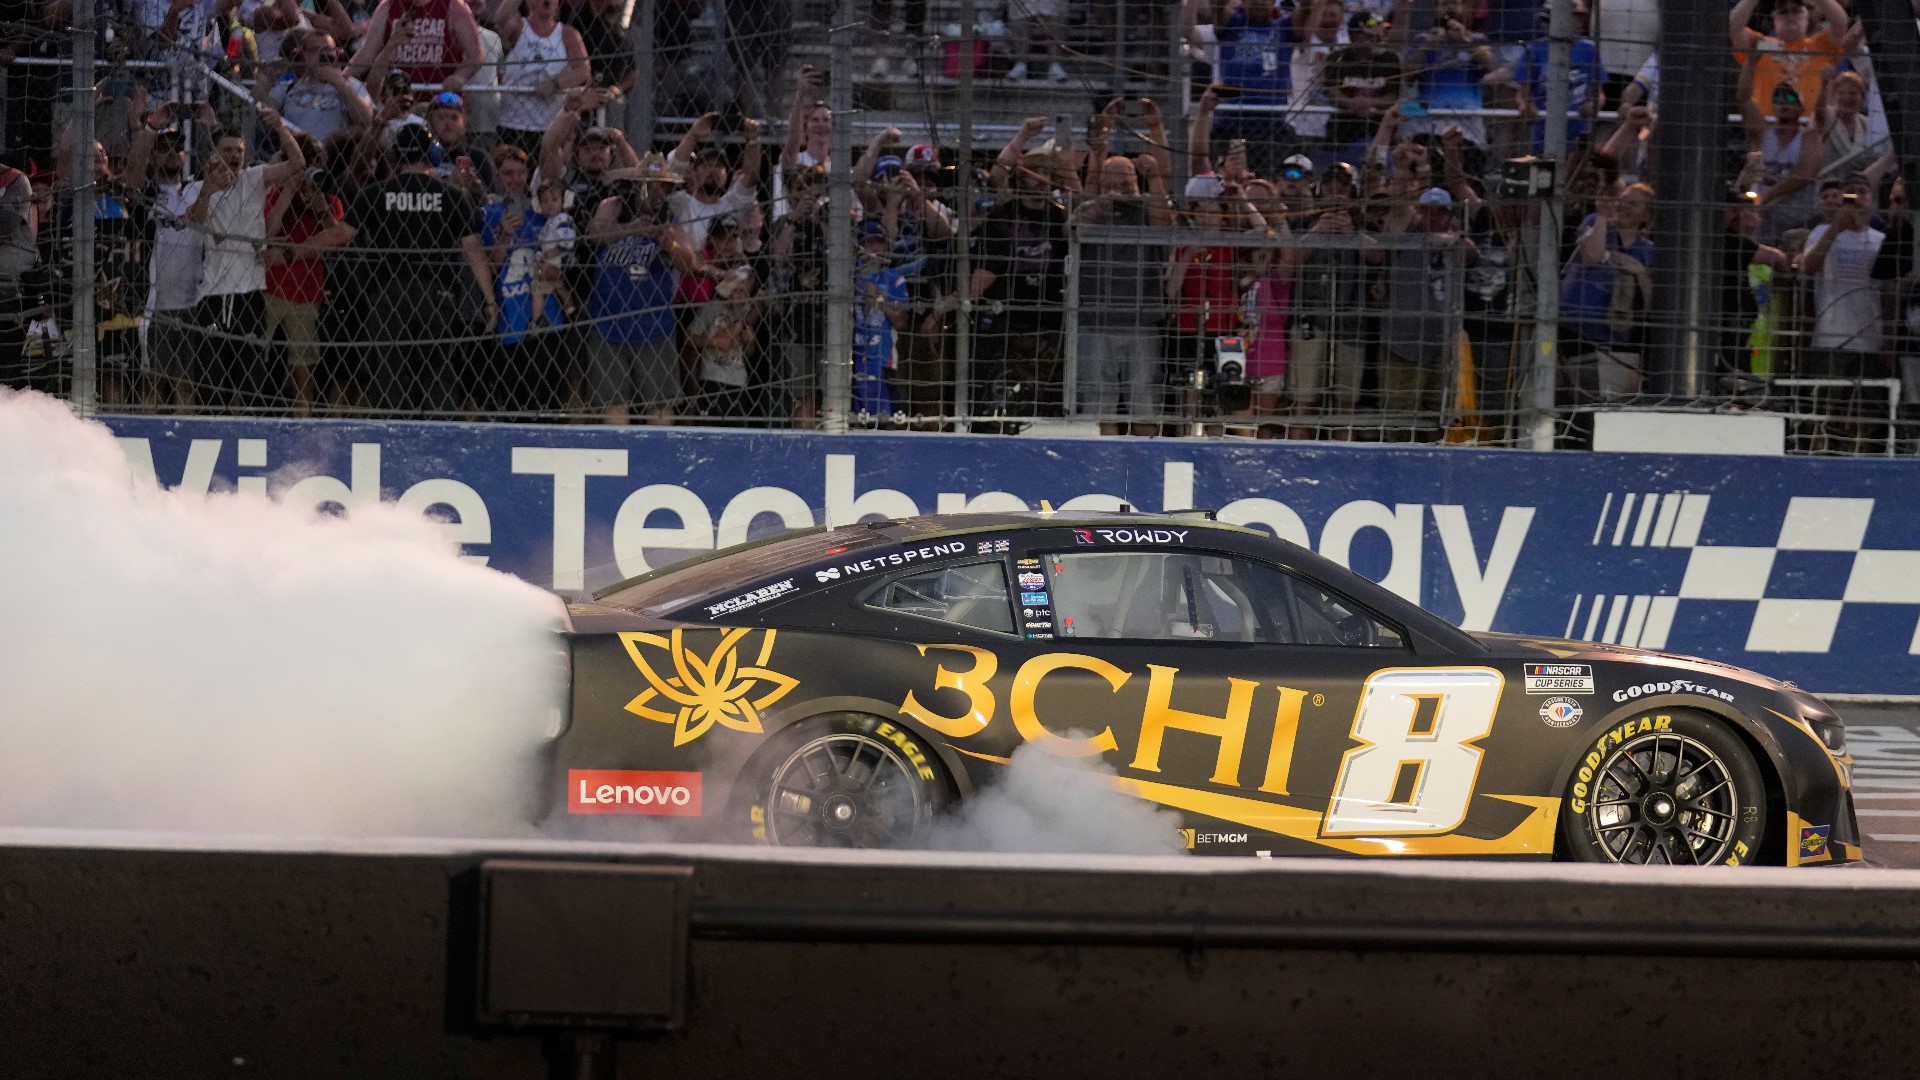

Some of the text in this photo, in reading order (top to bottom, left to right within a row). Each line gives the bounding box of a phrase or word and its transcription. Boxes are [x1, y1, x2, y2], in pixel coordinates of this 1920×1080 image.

[394, 43, 443, 63] ACECAR
[385, 191, 443, 212] POLICE
[1096, 529, 1189, 543] ROWDY
[844, 541, 966, 575] NETSPEND
[1035, 608, 1051, 618] ptc
[1545, 665, 1582, 676] NASCAR
[1535, 679, 1584, 688] CUP SERIES
[1612, 679, 1735, 703] GOODYEAR
[875, 711, 935, 781] EAGLE
[1320, 665, 1506, 838] 8
[580, 779, 691, 806] Lenovo
[1197, 833, 1248, 844] BETMGM
